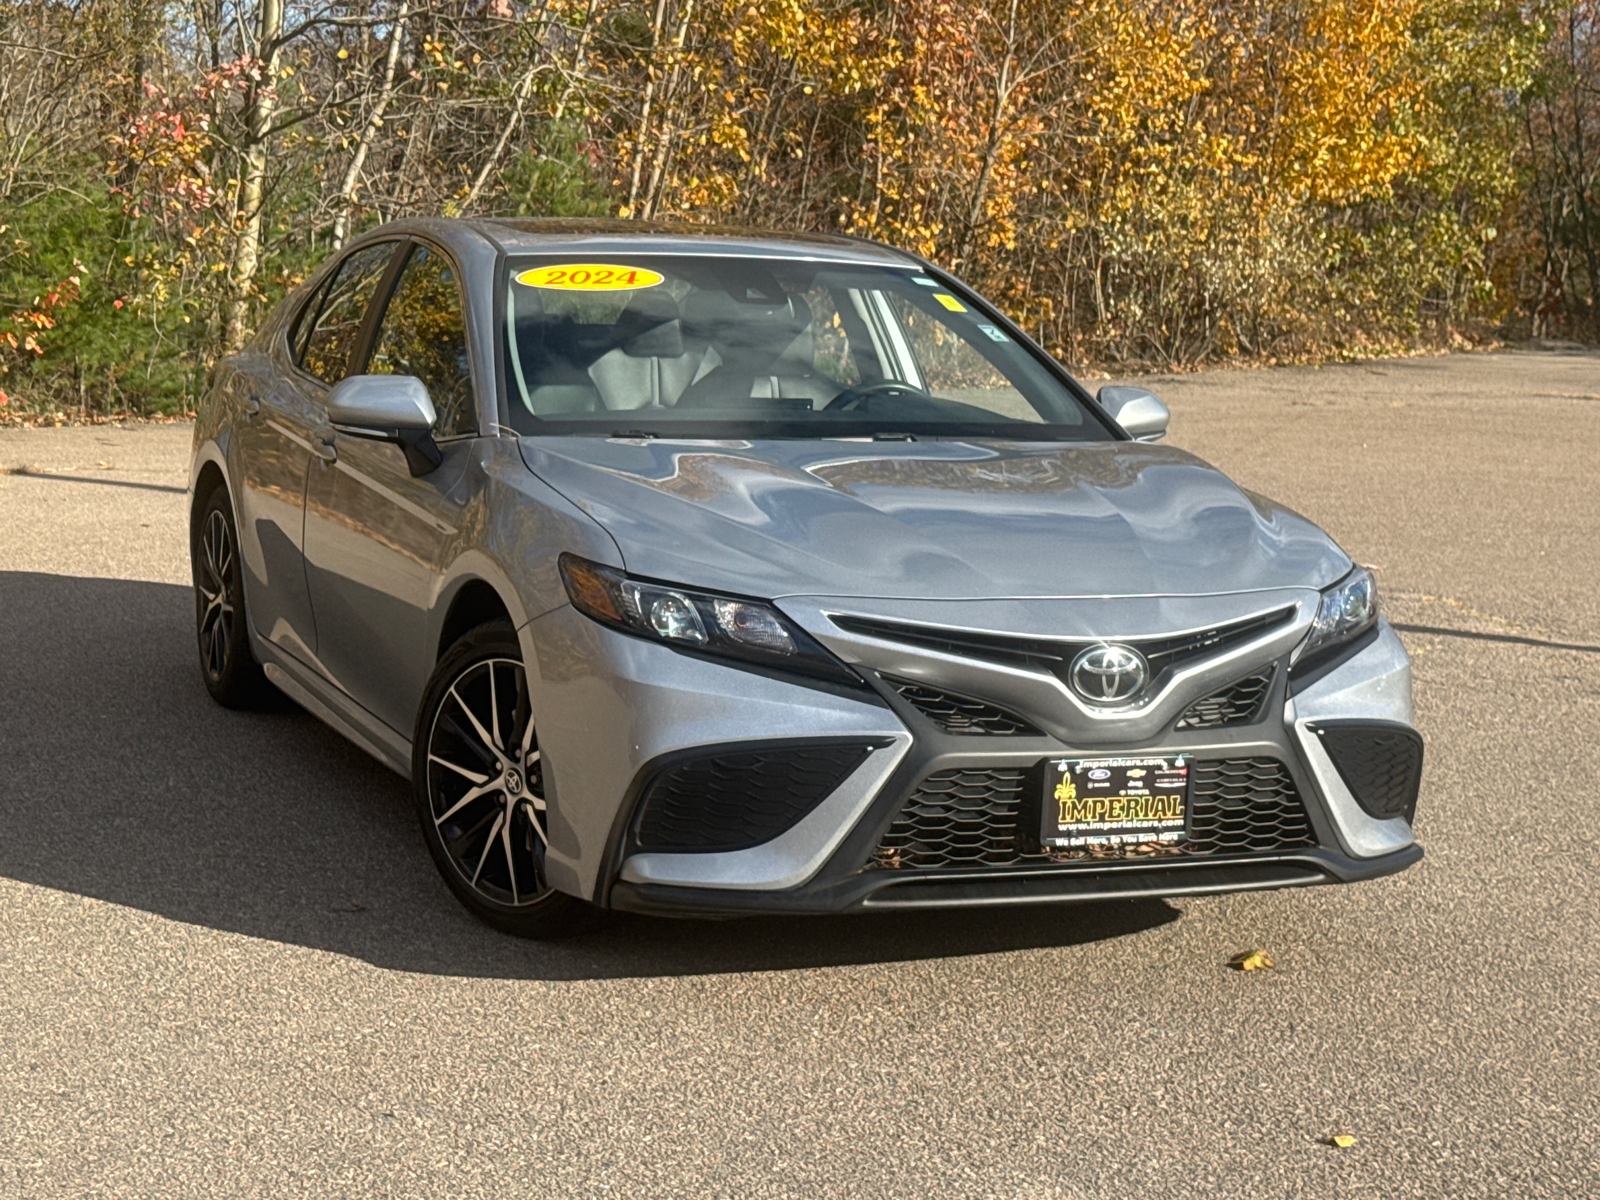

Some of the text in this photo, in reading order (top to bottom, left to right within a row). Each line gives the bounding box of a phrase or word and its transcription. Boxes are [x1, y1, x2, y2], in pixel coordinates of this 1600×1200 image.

[544, 270, 640, 285] 2024
[1058, 795, 1185, 823] IMPERIAL
[1058, 819, 1184, 831] www.imperialcars.com
